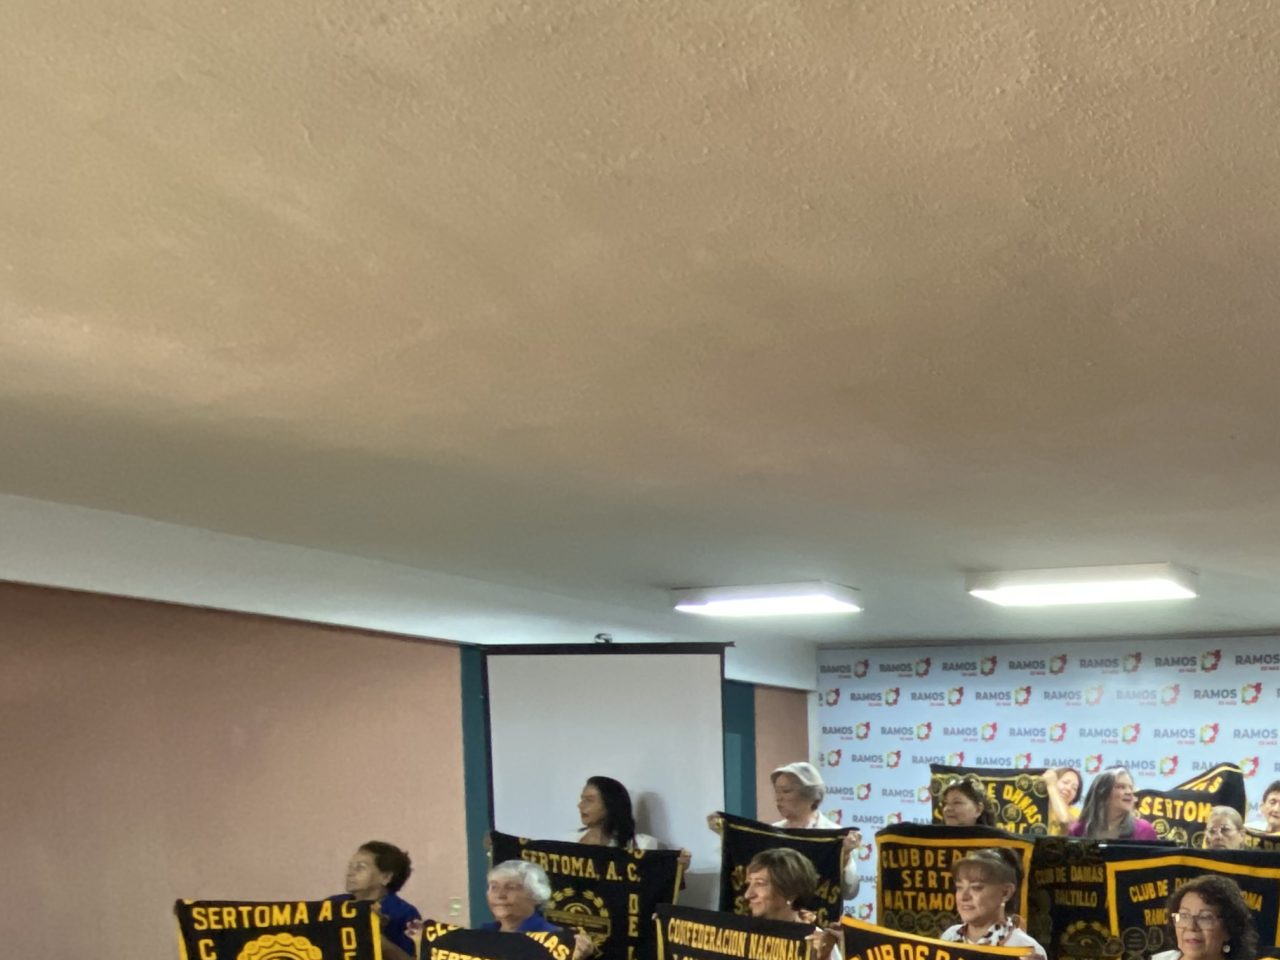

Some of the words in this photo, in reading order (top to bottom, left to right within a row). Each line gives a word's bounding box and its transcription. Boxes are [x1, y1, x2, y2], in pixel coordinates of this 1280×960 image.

[1079, 658, 1119, 668] RAMOS
[1154, 656, 1197, 667] RAMOS
[1235, 653, 1280, 665] RAMOS
[1008, 659, 1046, 670] RAMOS
[975, 691, 1011, 700] RAMOS
[1043, 690, 1082, 700] RAMOS
[1194, 689, 1237, 699] RAMOS
[881, 726, 913, 735] RAMOS
[943, 727, 978, 736] RAMOS
[1009, 728, 1046, 737] RAMOS
[1079, 728, 1119, 738] RAMOS
[1153, 729, 1196, 739] RAMOS
[1233, 729, 1278, 739] RAMOS
[1139, 796, 1212, 823] SERTOM
[882, 848, 920, 868] CLUB
[924, 850, 946, 867] DE
[903, 870, 953, 889] SERT
[1129, 882, 1156, 903] CLUB
[1157, 880, 1168, 896] DE
[883, 890, 957, 911] MATAMO
[192, 902, 309, 930] SERTOMA
[668, 918, 746, 957] CONFEDERACION
